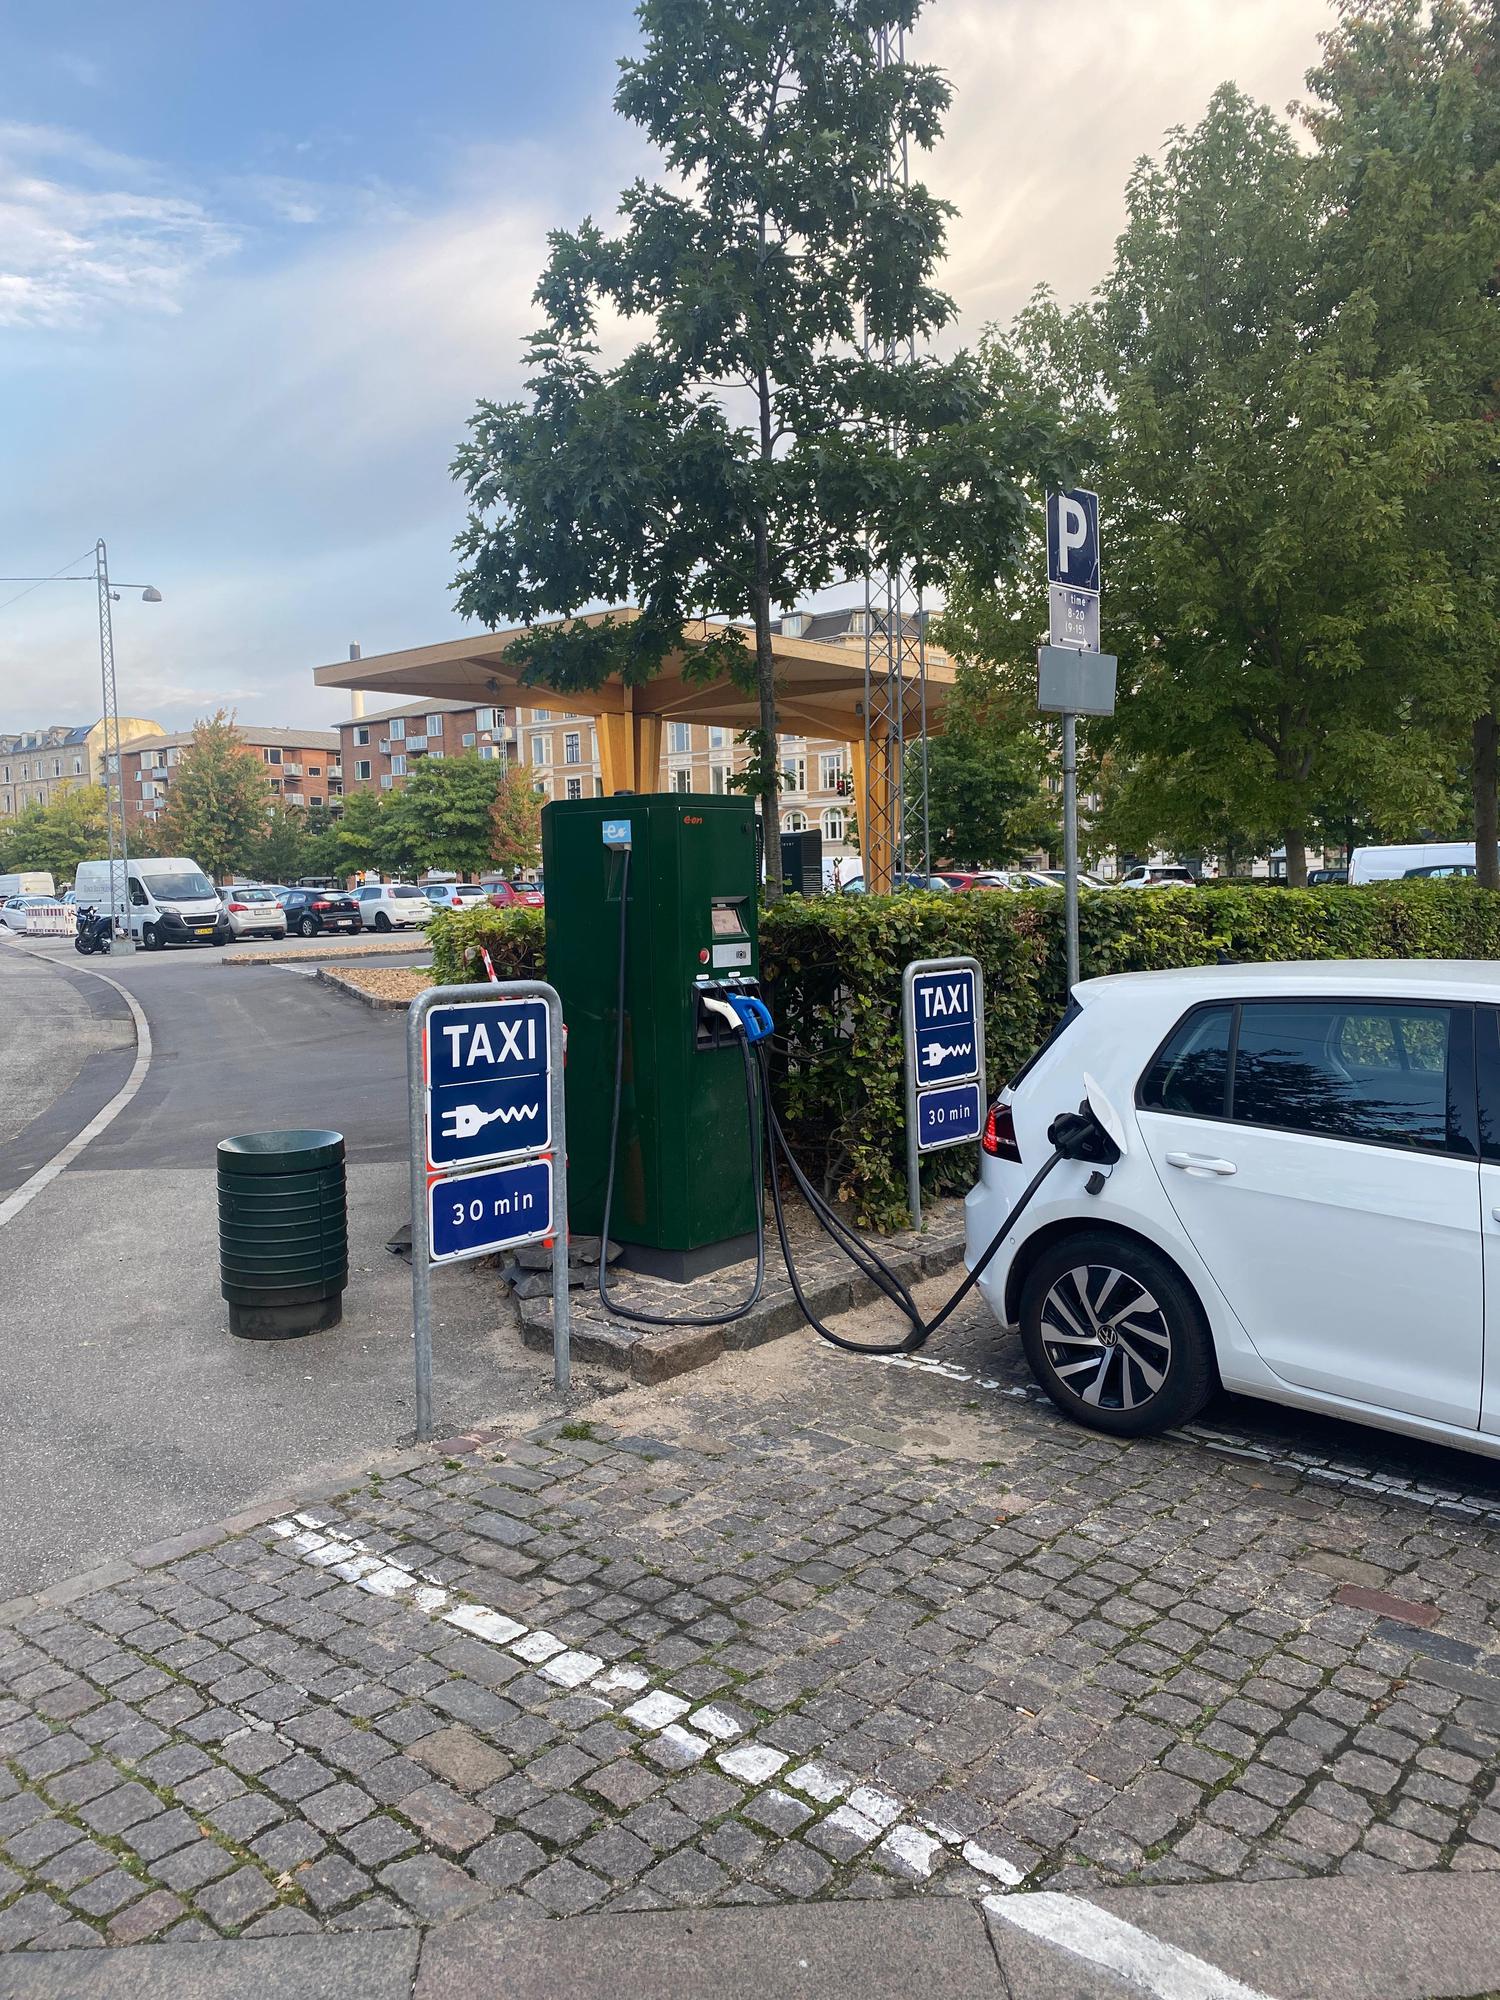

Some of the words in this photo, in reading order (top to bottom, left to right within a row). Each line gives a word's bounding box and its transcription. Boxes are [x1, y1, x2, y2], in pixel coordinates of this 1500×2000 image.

[1058, 495, 1088, 573] P
[1067, 607, 1085, 621] 8-20
[1070, 594, 1086, 607] time
[919, 983, 969, 1018] TAXI
[442, 1018, 536, 1068] TAXI
[928, 1107, 945, 1125] 30
[949, 1104, 971, 1121] min
[452, 1198, 484, 1226] 30
[493, 1191, 534, 1217] min
